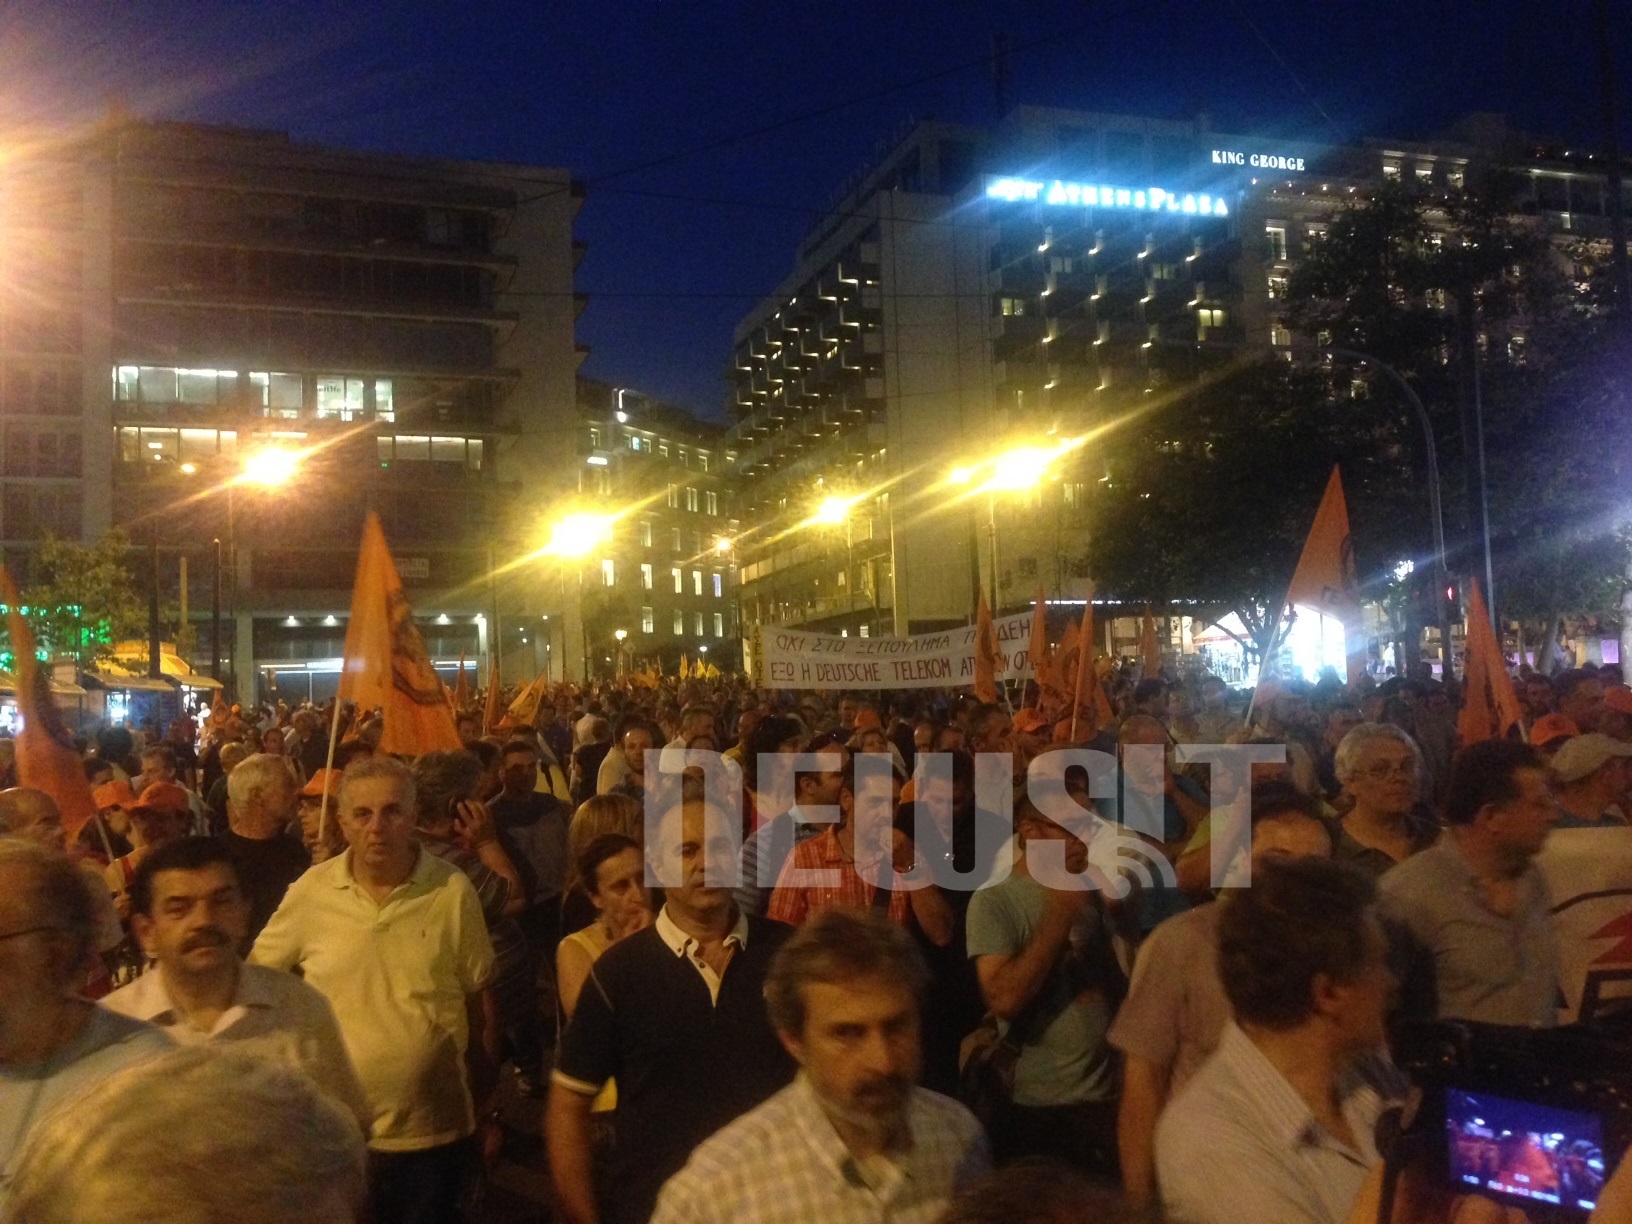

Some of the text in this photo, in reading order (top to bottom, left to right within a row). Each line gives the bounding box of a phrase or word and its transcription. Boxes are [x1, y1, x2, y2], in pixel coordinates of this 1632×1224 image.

[1212, 150, 1305, 171] KING GEORGE
[776, 634, 805, 652] ΟΧΙ
[811, 637, 846, 652] ΣΤΟ
[997, 617, 1031, 642] ΔΕΗ
[816, 662, 882, 682] DEUTSCHE
[890, 657, 952, 681] TELEKOM
